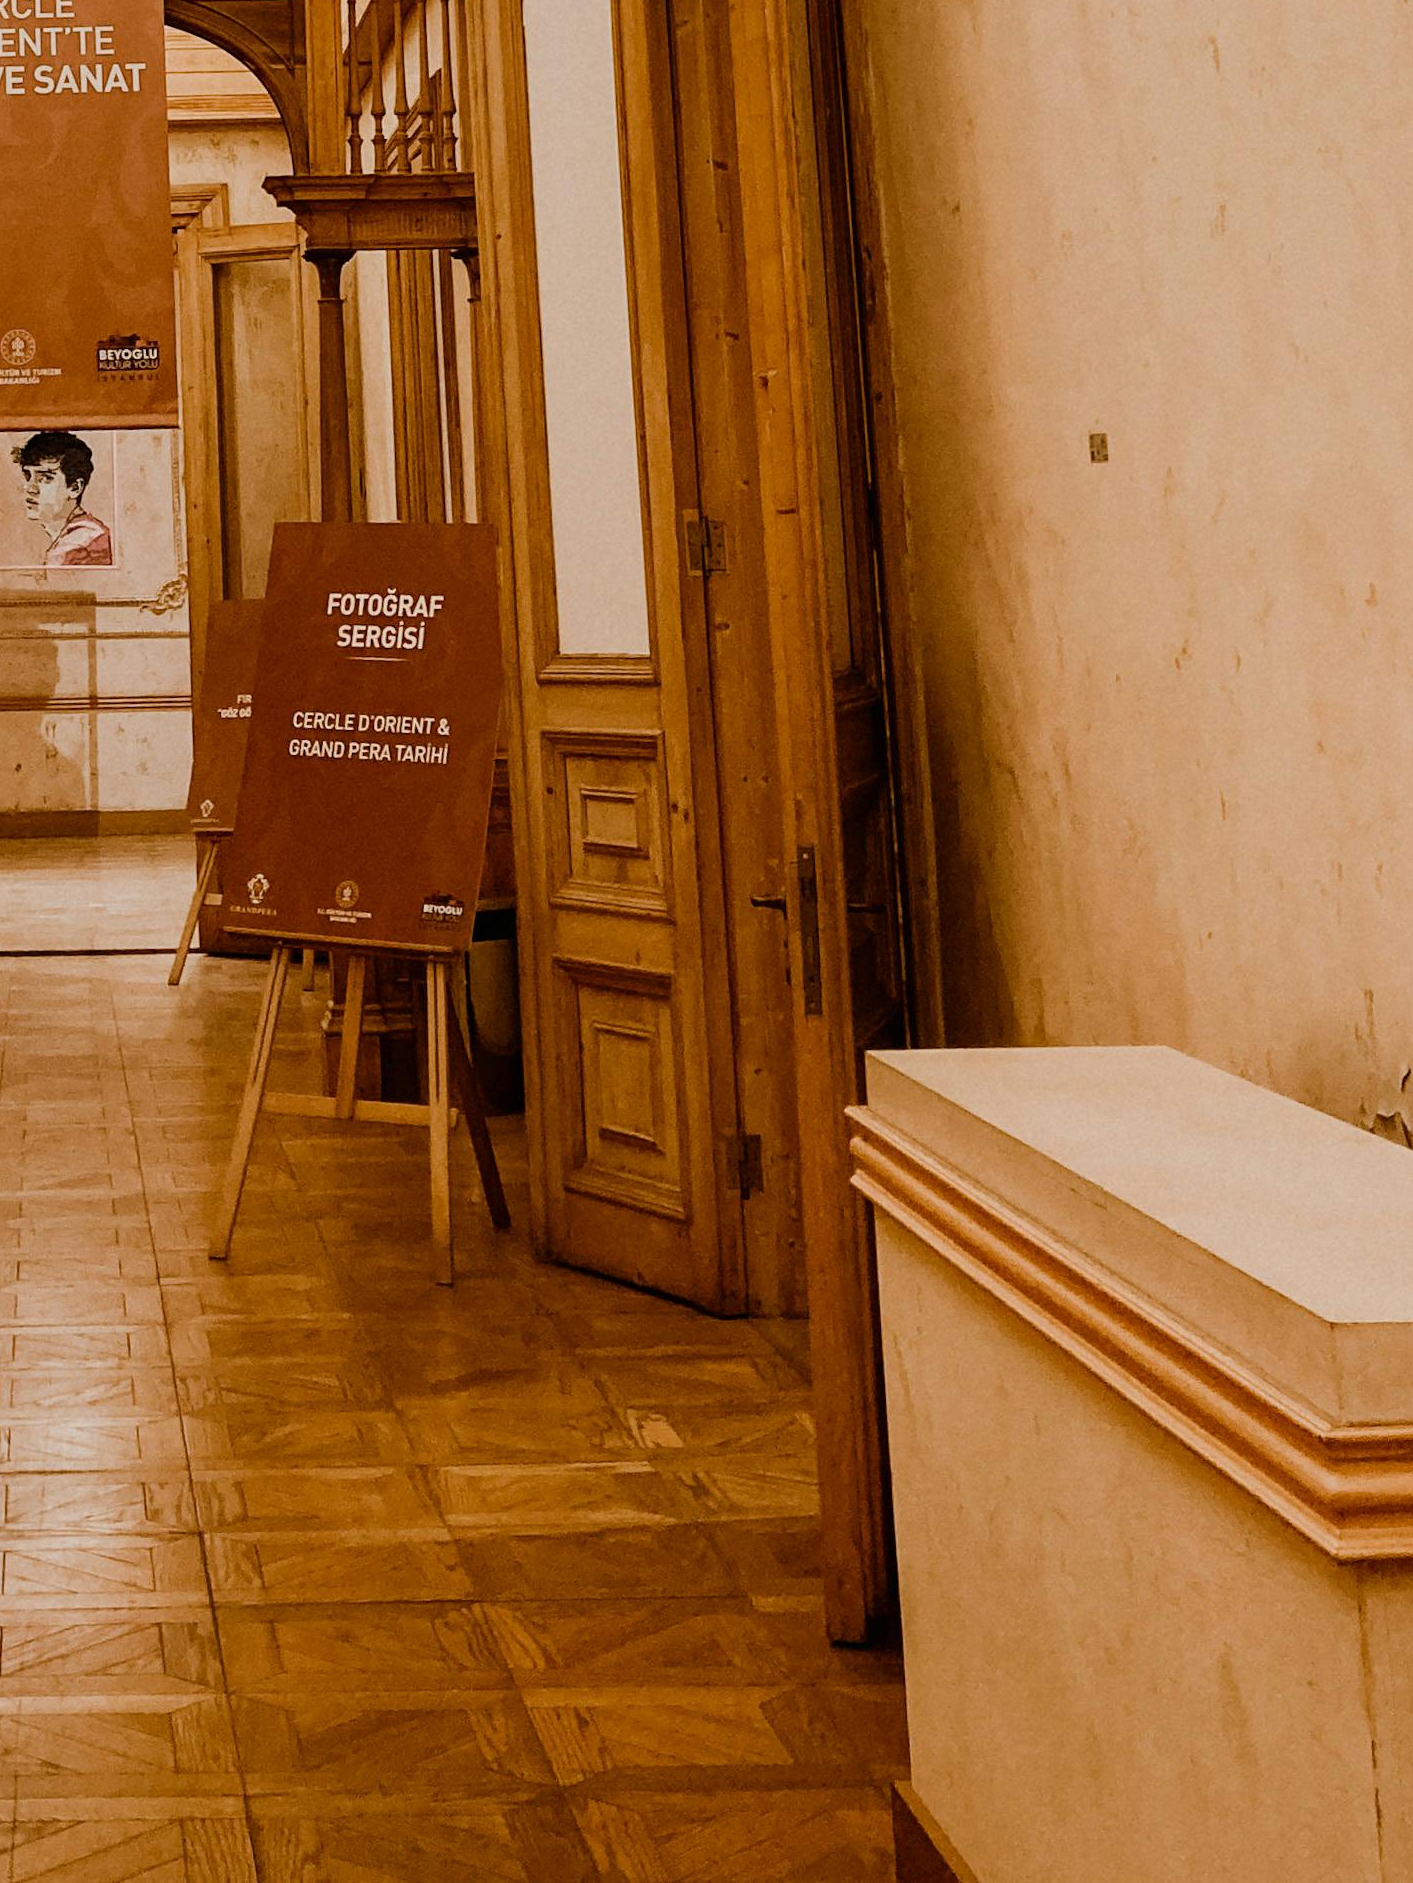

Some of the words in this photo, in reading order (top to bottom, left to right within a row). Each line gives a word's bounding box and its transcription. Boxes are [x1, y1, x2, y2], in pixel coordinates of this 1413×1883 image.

[34, 62, 146, 94] SANAT
[326, 588, 445, 618] FOTOĞRAF
[336, 620, 426, 650] SERGİSİ
[292, 711, 356, 731] CERCLE
[357, 714, 435, 735] D'ORIENT
[437, 718, 451, 736] &
[288, 738, 345, 759] GRAND
[347, 741, 391, 762] PERA
[395, 742, 449, 765] TARİHİ
